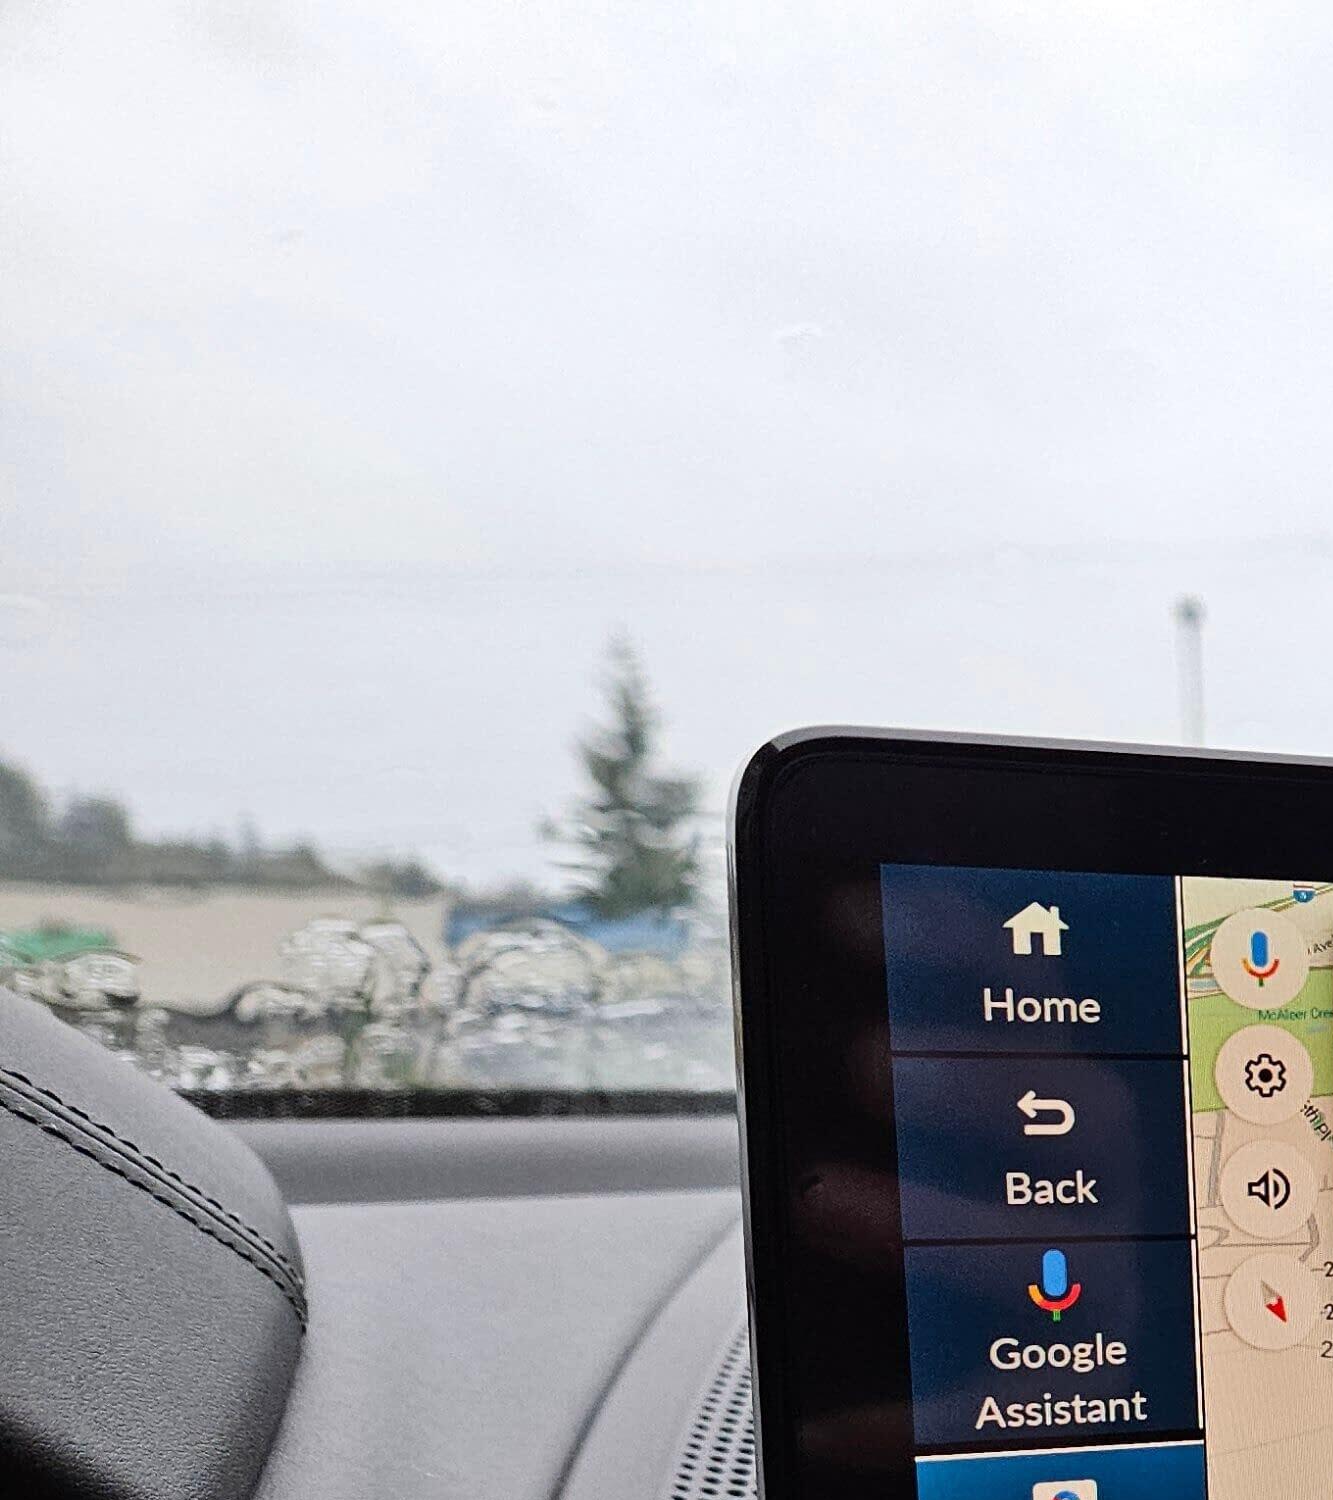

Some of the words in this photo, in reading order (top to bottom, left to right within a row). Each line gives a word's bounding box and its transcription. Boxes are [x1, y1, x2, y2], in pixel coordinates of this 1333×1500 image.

[983, 987, 1101, 1023] Home
[1006, 1170, 1099, 1205] Back
[989, 1332, 1127, 1373] Google
[975, 1391, 1148, 1430] Assistant
